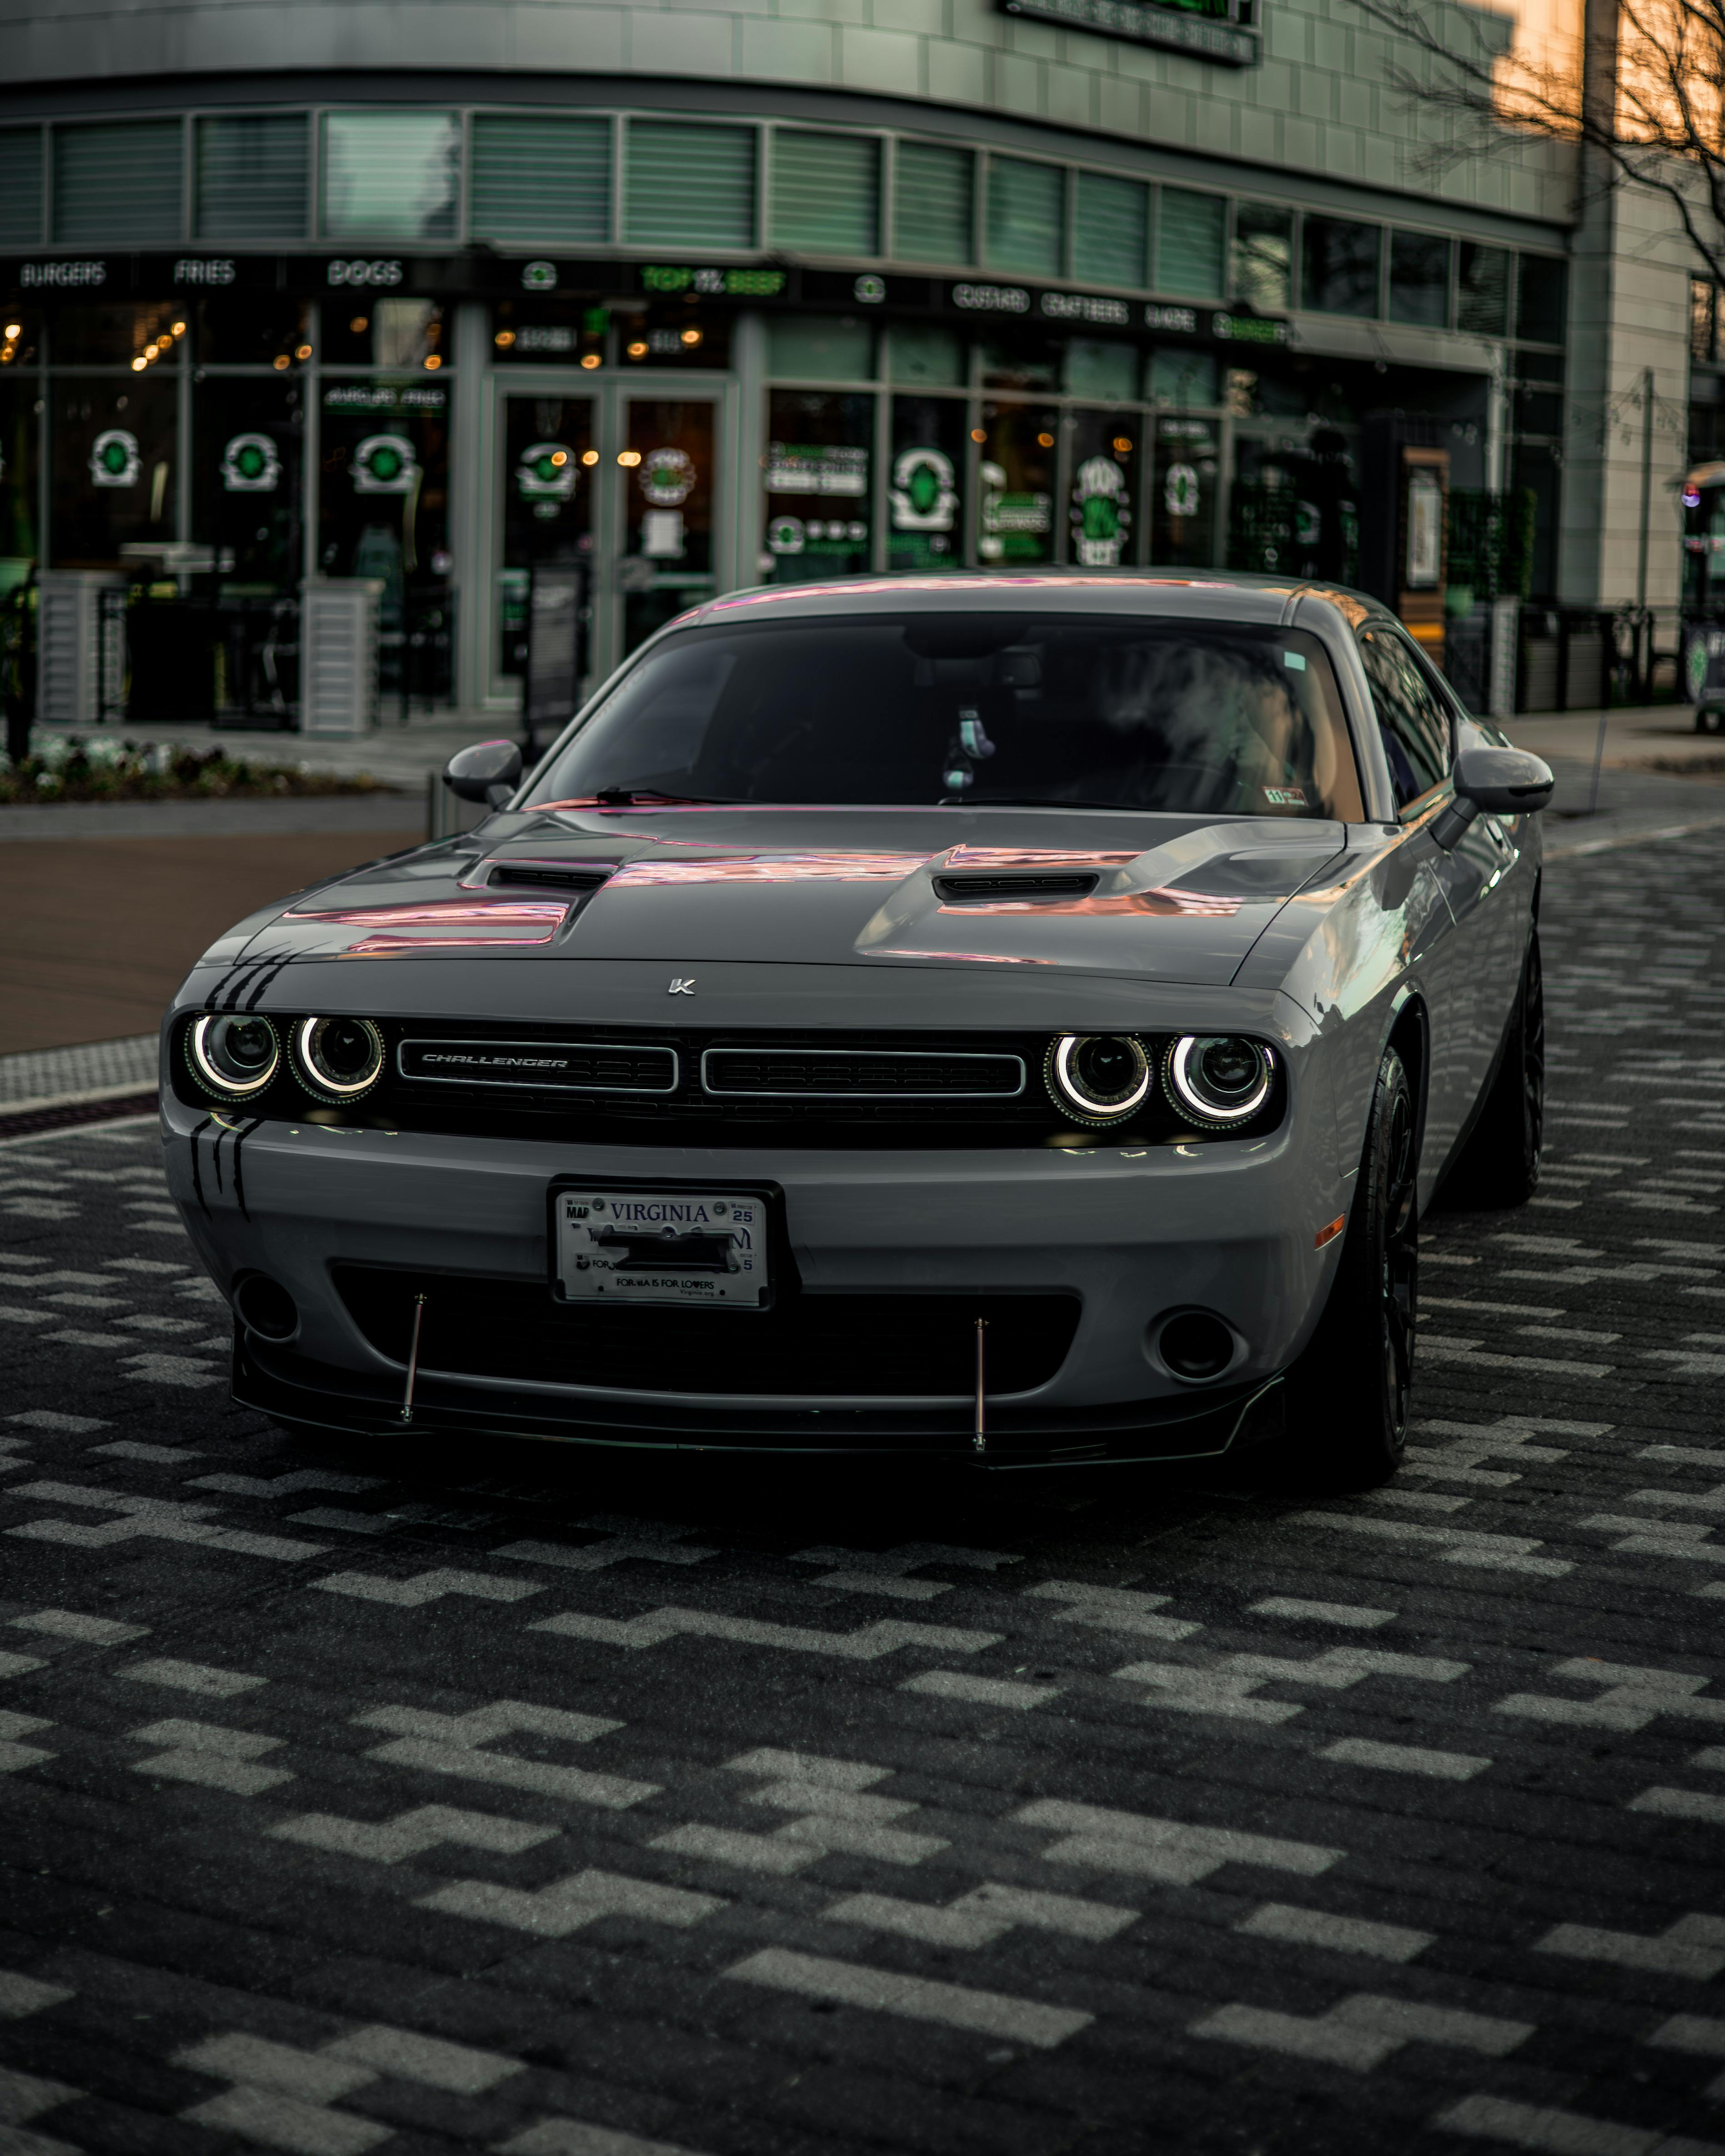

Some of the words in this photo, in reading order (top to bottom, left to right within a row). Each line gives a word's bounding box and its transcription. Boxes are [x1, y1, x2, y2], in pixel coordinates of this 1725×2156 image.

[20, 261, 106, 287] BURGERS
[174, 260, 236, 285] FRIES
[327, 260, 402, 286] DOGS
[421, 1054, 570, 1069] CHALLENGER
[611, 1203, 710, 1222] VIRGINIA
[733, 1210, 753, 1222] 25
[744, 1259, 753, 1271] 5
[652, 1279, 659, 1287] IS
[661, 1279, 679, 1288] FOR
